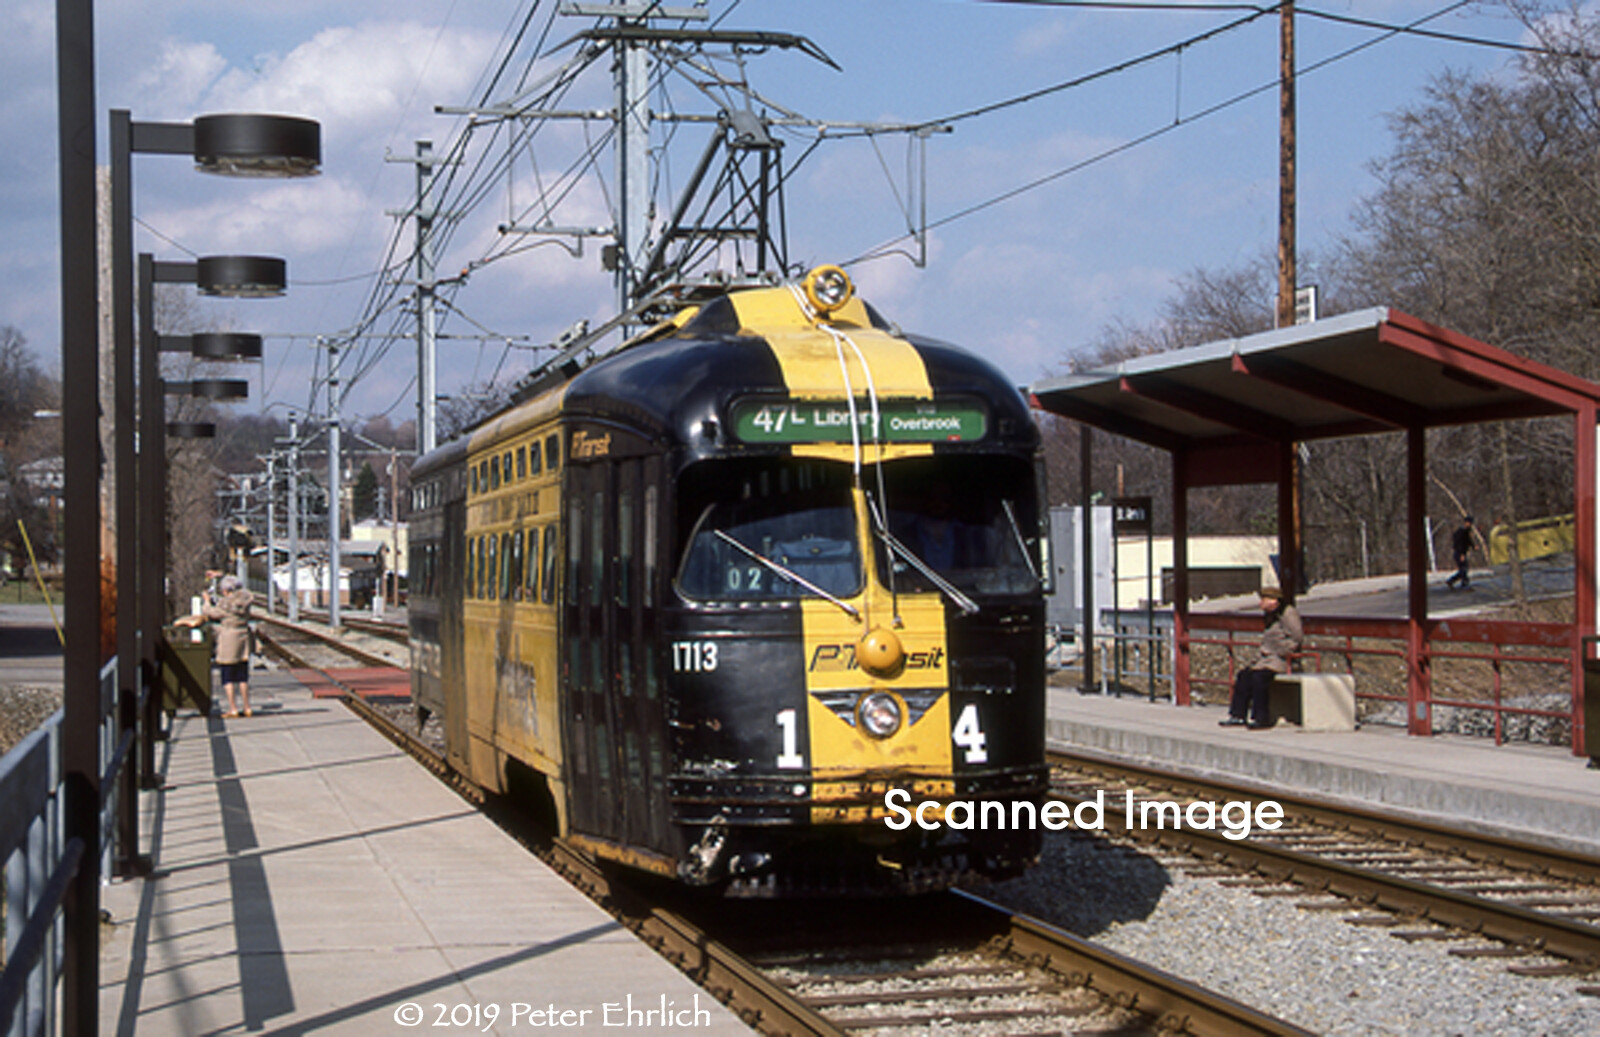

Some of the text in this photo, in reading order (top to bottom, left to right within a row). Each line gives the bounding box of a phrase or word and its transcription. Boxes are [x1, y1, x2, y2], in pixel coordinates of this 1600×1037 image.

[814, 408, 880, 432] Librr
[890, 416, 961, 431] Overbrook
[672, 641, 717, 671] 1713
[808, 644, 945, 672] PTsit
[776, 708, 803, 769] 1
[953, 704, 988, 763] 4
